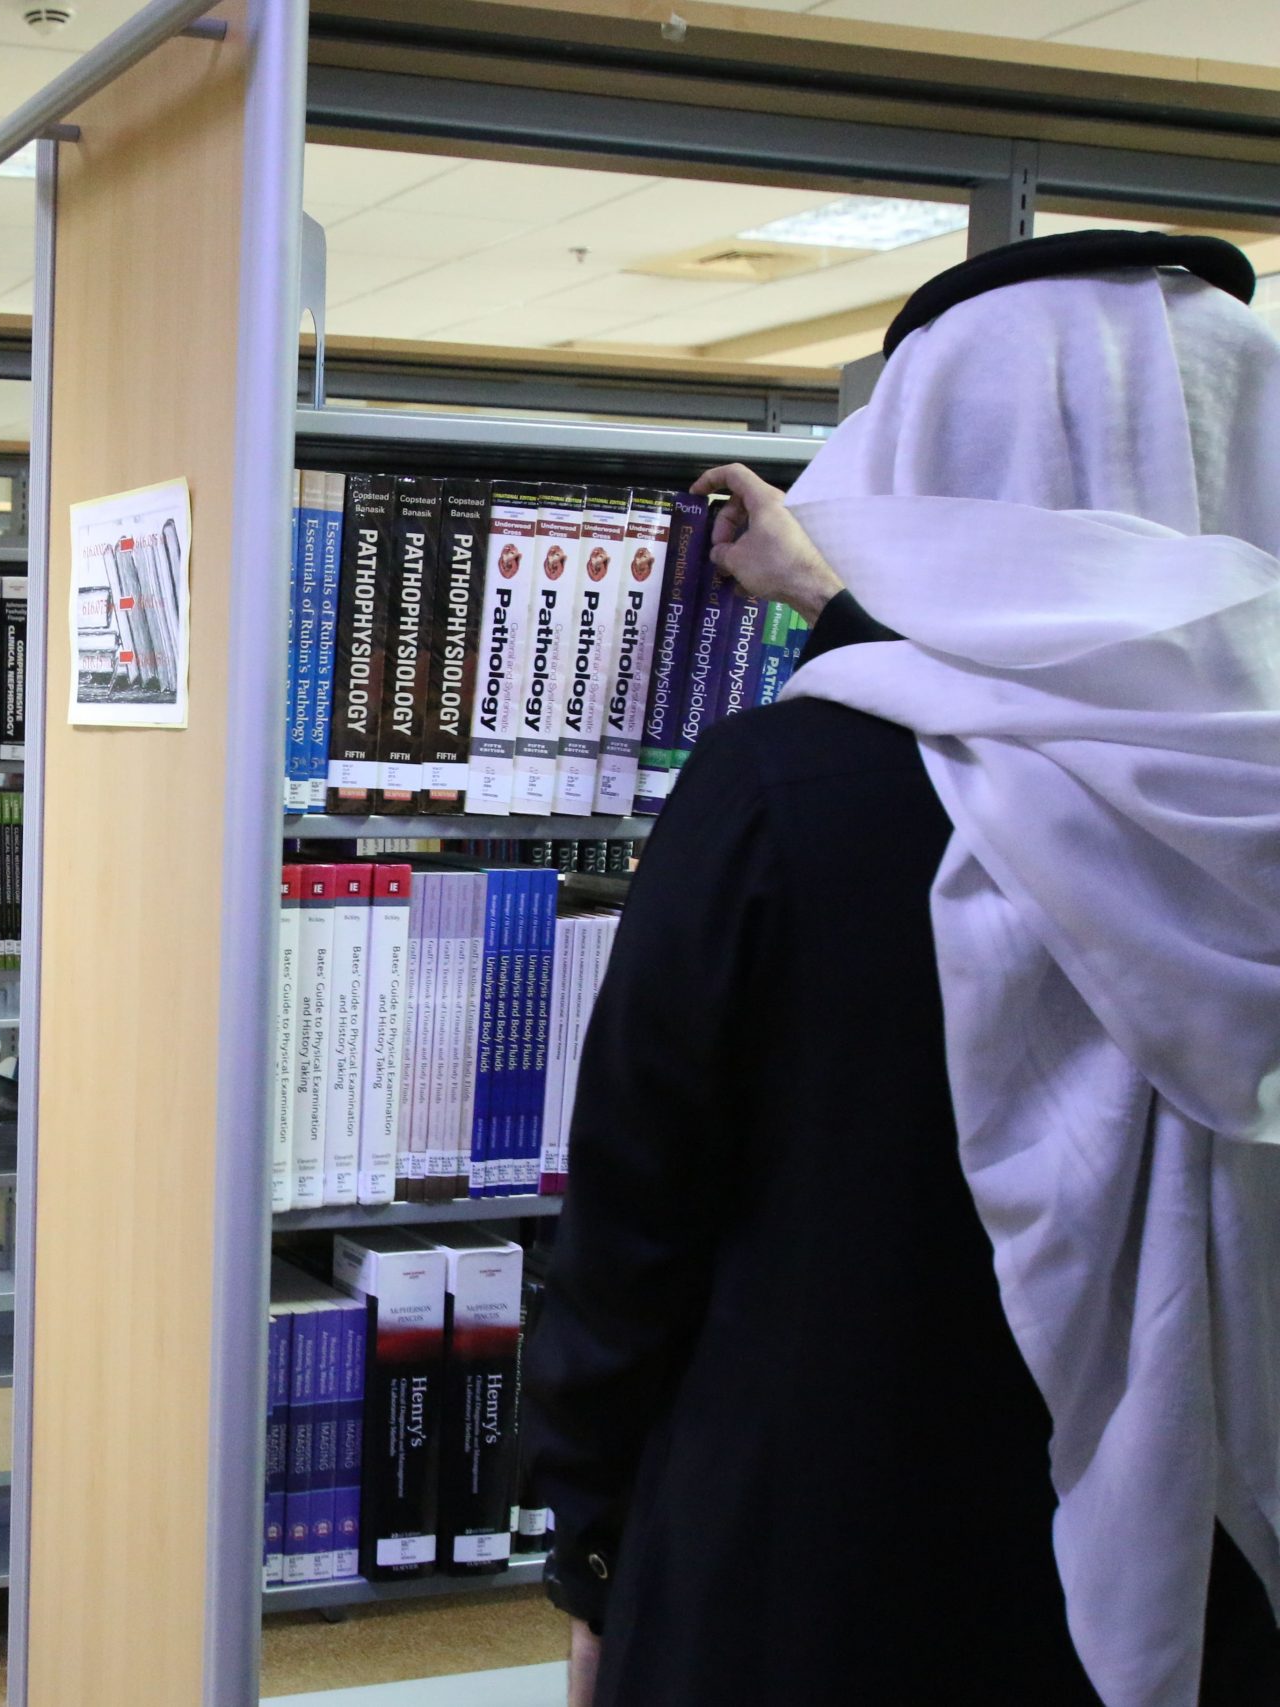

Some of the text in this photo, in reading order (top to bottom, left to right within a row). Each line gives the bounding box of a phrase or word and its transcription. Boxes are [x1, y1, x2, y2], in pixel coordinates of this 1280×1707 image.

[353, 491, 389, 500] Copstead
[356, 505, 385, 514] Banasik
[400, 495, 436, 504] Copstead
[402, 508, 432, 517] Banasik
[448, 496, 484, 506] Copstead
[451, 510, 480, 518] Banasik
[494, 521, 531, 530] Underwood
[541, 523, 576, 532] Underwood
[584, 524, 620, 534] Underwood
[630, 525, 664, 534] Underwood
[675, 502, 702, 515] Porth
[302, 519, 318, 594] Essentials
[672, 525, 693, 586] Essentials
[302, 598, 314, 616] of
[312, 521, 338, 746] Essentials of Rubin's Pathology
[347, 529, 378, 734] PATHOPHYSIOLOGY
[393, 532, 425, 736] PATHOPHYSIOLOGY
[439, 533, 473, 736] PATHOPHYSIOLOGY
[770, 612, 782, 642] Review
[299, 619, 313, 673] Rubin's
[481, 588, 512, 732] Pathology
[525, 590, 557, 732] Pathology
[566, 591, 599, 732] Pathology
[608, 591, 643, 731] Pathology
[647, 604, 683, 740] Pathophysiology
[683, 608, 720, 742] Pathophysiology
[727, 606, 758, 716] Pathophysiol
[292, 679, 310, 745] Pathology
[345, 751, 365, 759] FIFTH
[390, 752, 410, 760] FIFTH
[436, 752, 456, 760] FIFTH
[280, 949, 292, 1143] Bates' Guide to Physical Examination
[298, 997, 312, 1093] and History Taking
[311, 948, 326, 1140] Bates' Guide to Physical Examination
[334, 995, 348, 1090] and History Taking
[347, 946, 361, 1137] Bates' Guide to Physical Examination
[373, 994, 387, 1089] and History Taking
[385, 946, 400, 1135] Bates' Guide to Physical Examination
[480, 957, 496, 1072] Urinalysis and Body Fluids
[494, 956, 510, 1071] Urinalysis and Body Fluids
[508, 955, 524, 1070] Urinalysis and Body Fluids
[522, 955, 538, 1070] Urinalysis and Body Fluids
[536, 956, 551, 1070] Urinalysis and Body Fluids
[344, 1420, 355, 1469] IMAGING
[407, 1376, 427, 1447] Henry's
[482, 1374, 502, 1443] Henry's
[296, 1425, 306, 1474] IMAGING
[320, 1422, 330, 1471] IMAGING
